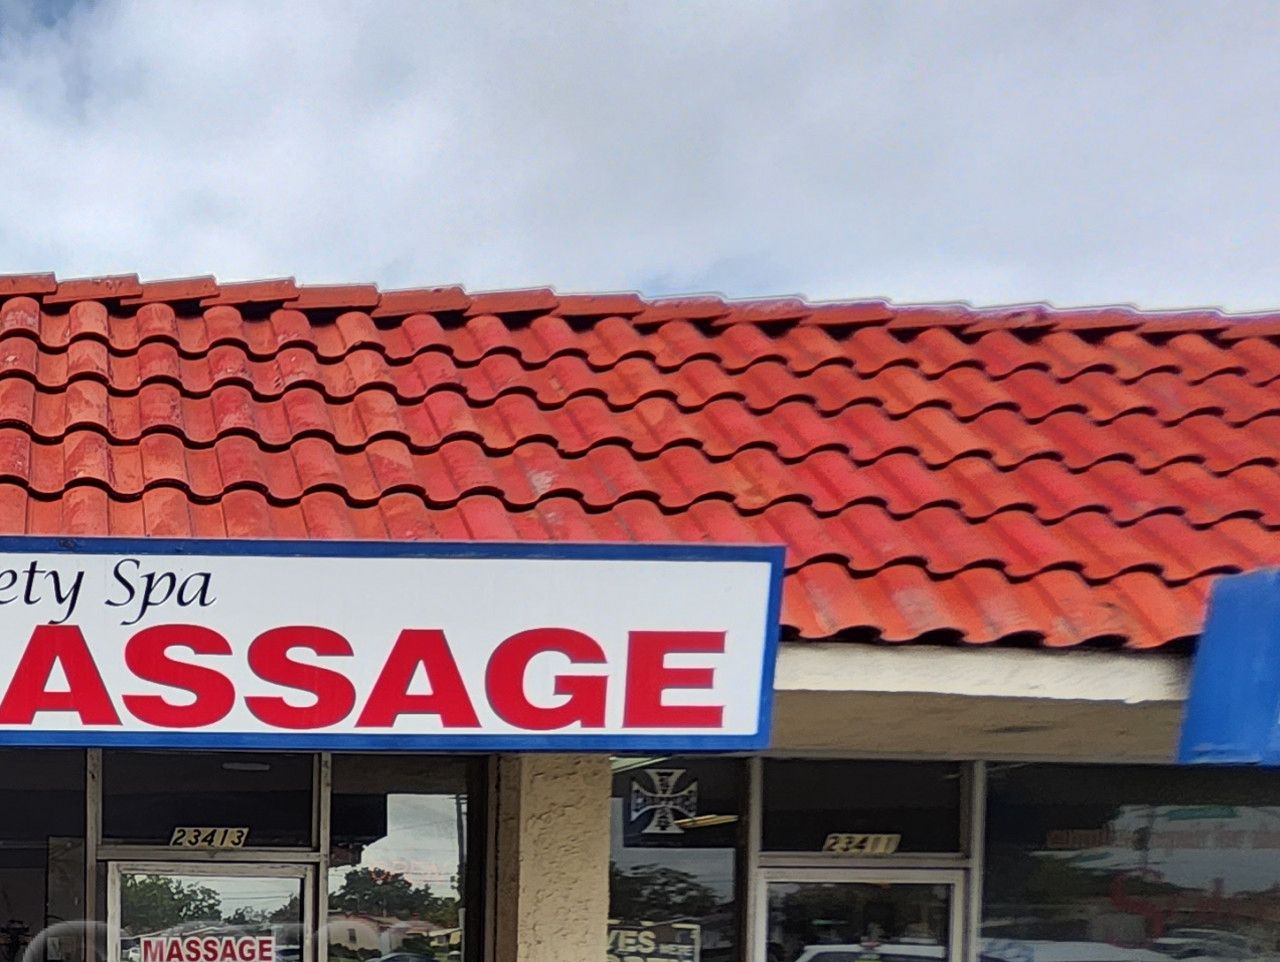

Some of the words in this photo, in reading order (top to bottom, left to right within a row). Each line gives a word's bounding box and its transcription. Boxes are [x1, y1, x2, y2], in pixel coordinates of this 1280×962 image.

[105, 558, 217, 626] Spa
[172, 829, 245, 846] 23413
[143, 939, 273, 962] MASSAGE
